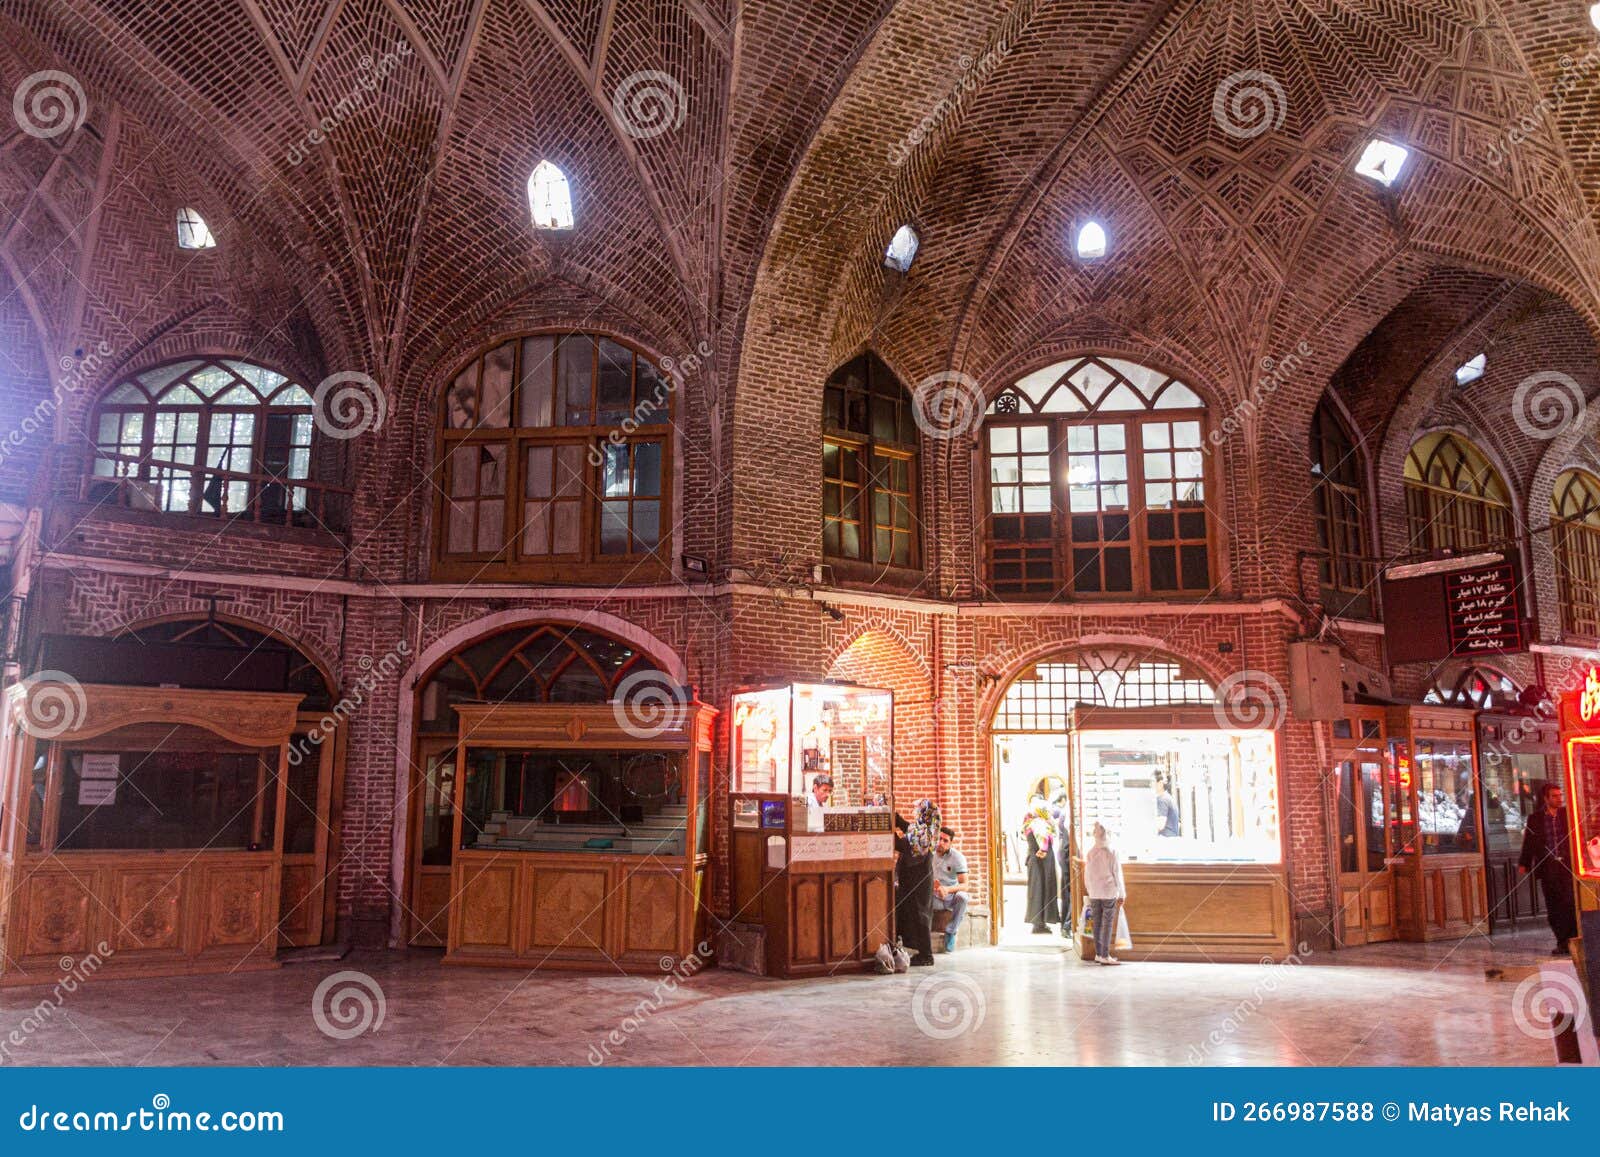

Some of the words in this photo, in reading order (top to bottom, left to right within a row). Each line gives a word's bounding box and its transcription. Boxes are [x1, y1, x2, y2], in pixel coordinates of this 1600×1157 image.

[1460, 574, 1475, 583] طلا
[1484, 583, 1505, 594] مثقال
[1463, 613, 1483, 624] امام
[1484, 610, 1502, 619] سکه
[1467, 627, 1485, 635] سکه
[1469, 639, 1487, 648] سکه
